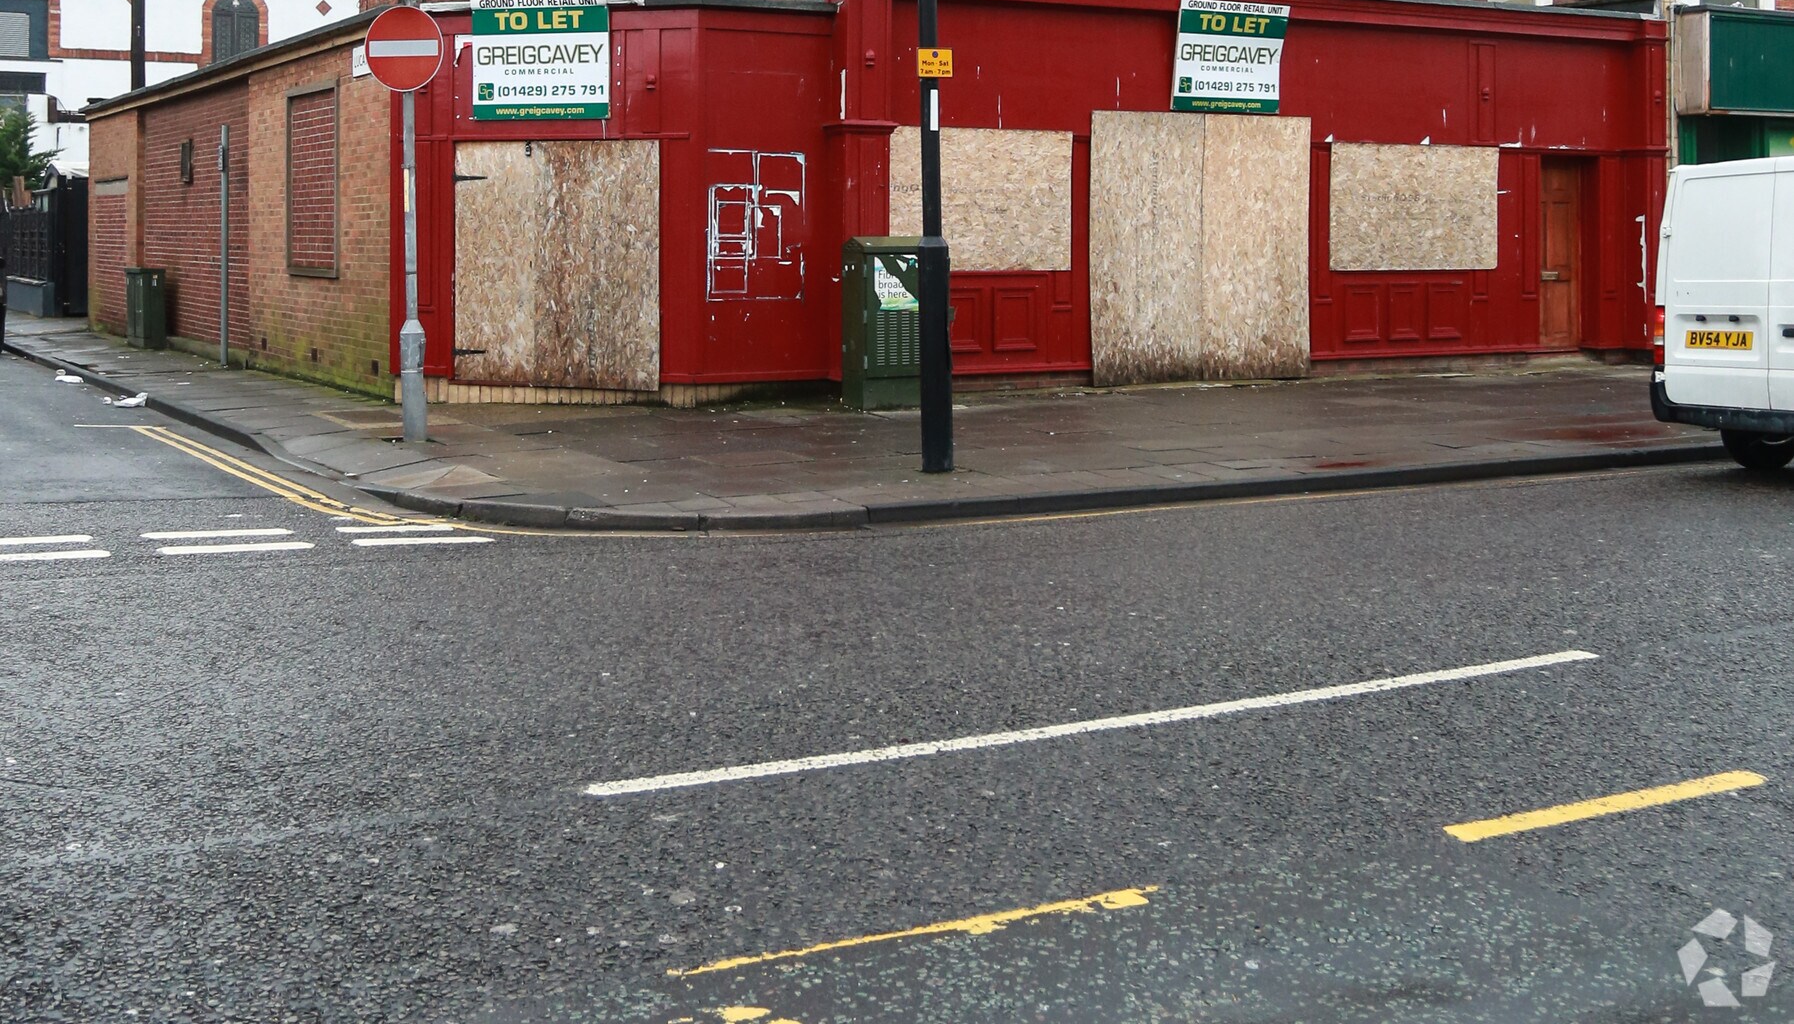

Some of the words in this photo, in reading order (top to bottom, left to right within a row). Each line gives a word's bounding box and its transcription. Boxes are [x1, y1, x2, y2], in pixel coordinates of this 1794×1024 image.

[479, 0, 514, 8] GROUND
[1188, 0, 1217, 10] GROUND
[1220, 2, 1241, 12] FLOOR
[1244, 4, 1266, 14] RETAIL
[1268, 6, 1284, 14] UNIT
[494, 12, 528, 30] TO
[537, 10, 584, 29] LET
[1200, 14, 1226, 31] TO
[1232, 16, 1270, 34] LET
[477, 44, 604, 66] GREIGCAVEY
[1180, 43, 1279, 65] GREIGCAVEY
[504, 68, 574, 76] COMMERCIAL
[1200, 65, 1254, 73] COMMERCIAL
[498, 85, 547, 97] (01429)
[552, 85, 576, 96] 275
[581, 85, 604, 95] 791
[1195, 80, 1233, 92] (01429)
[1236, 82, 1254, 92] 275
[1258, 83, 1276, 93] 791
[496, 106, 584, 116] www.greigcavey.com
[1192, 100, 1261, 110] www.greigcavey.com
[878, 289, 886, 298] is
[888, 289, 908, 298] here
[1690, 332, 1720, 346] BV54
[1724, 333, 1747, 347] YJA
